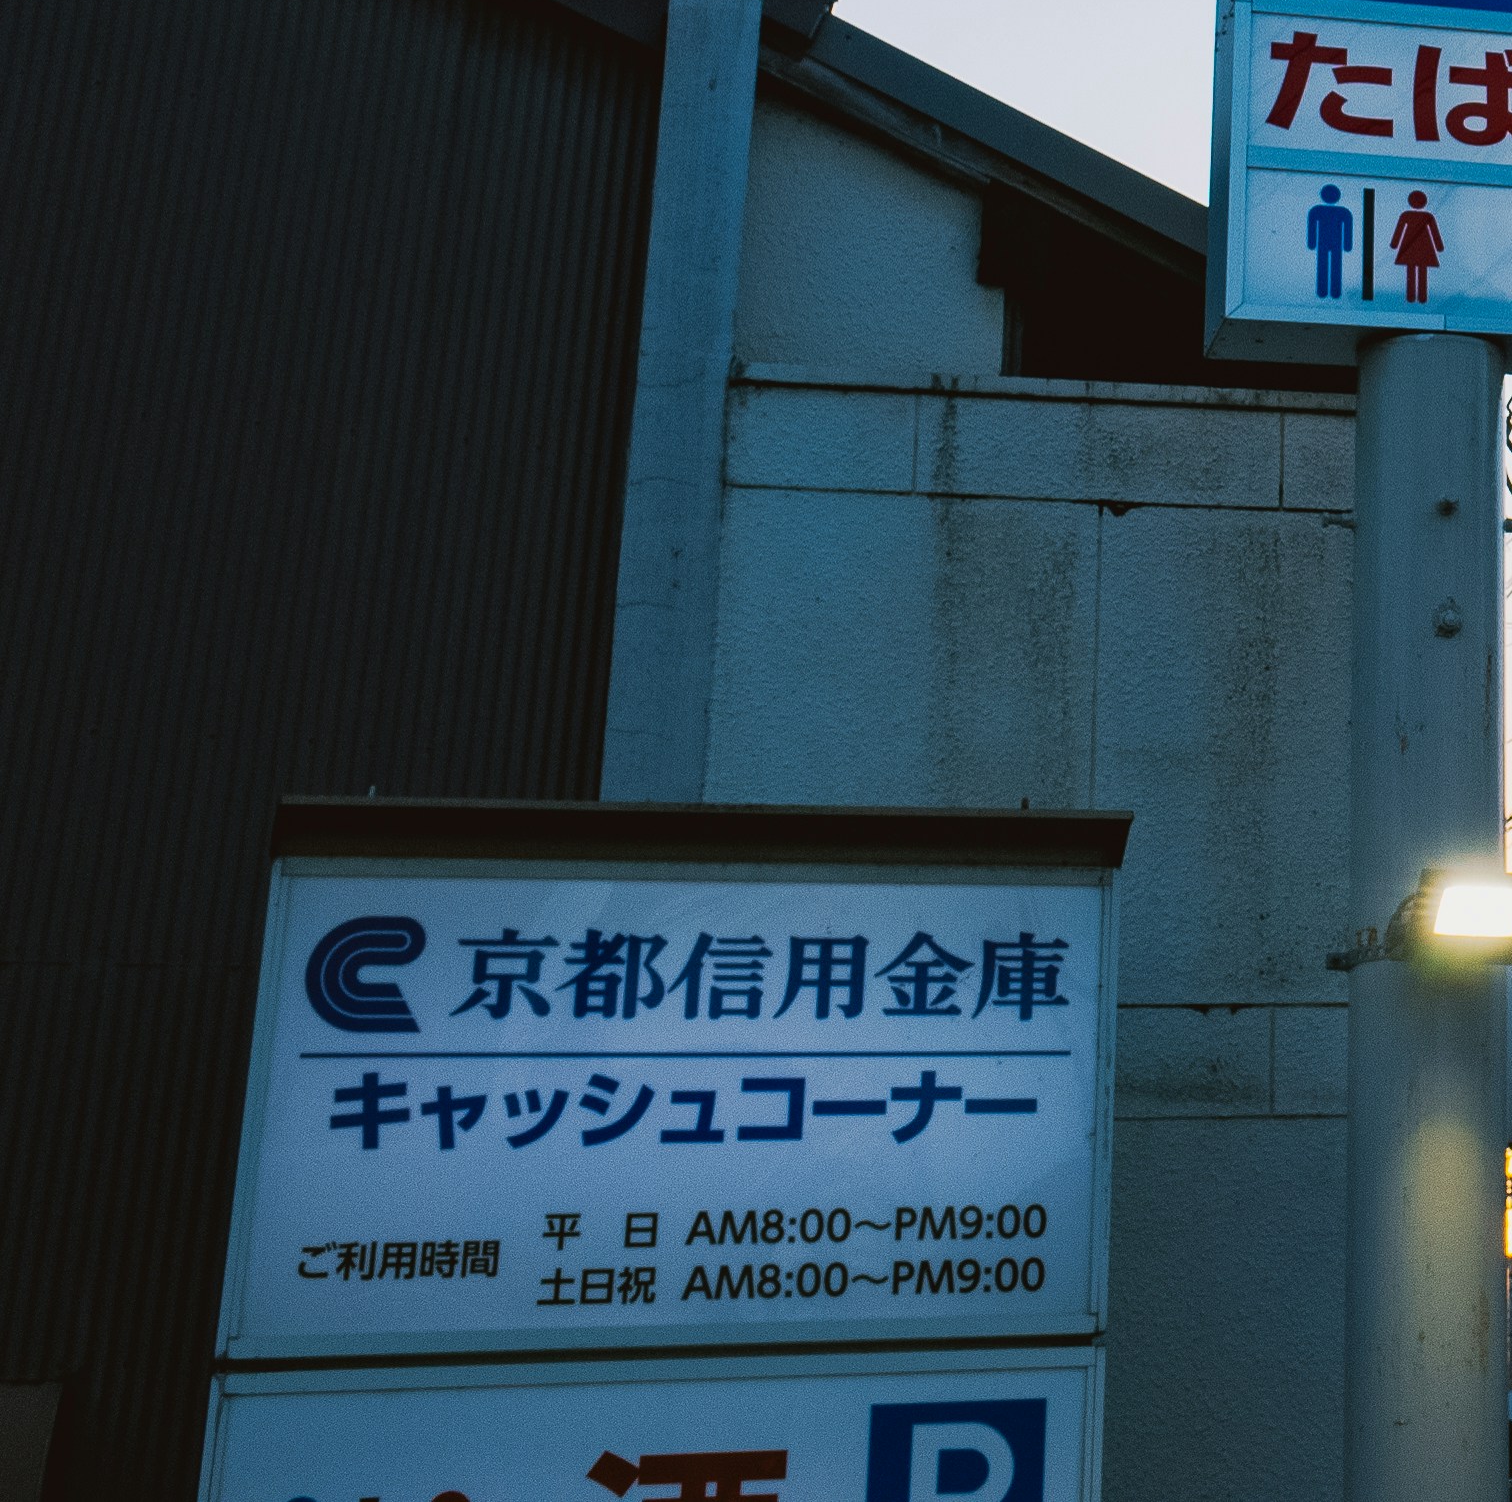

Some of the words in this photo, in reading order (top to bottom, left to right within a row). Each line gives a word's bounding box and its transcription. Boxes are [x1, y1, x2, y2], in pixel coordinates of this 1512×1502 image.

[448, 929, 1071, 1022] 京都信用金庫
[329, 1070, 1038, 1150] キャッシュコーナー
[298, 1239, 501, 1281] ご利用時間
[536, 1267, 657, 1306] 土日祝
